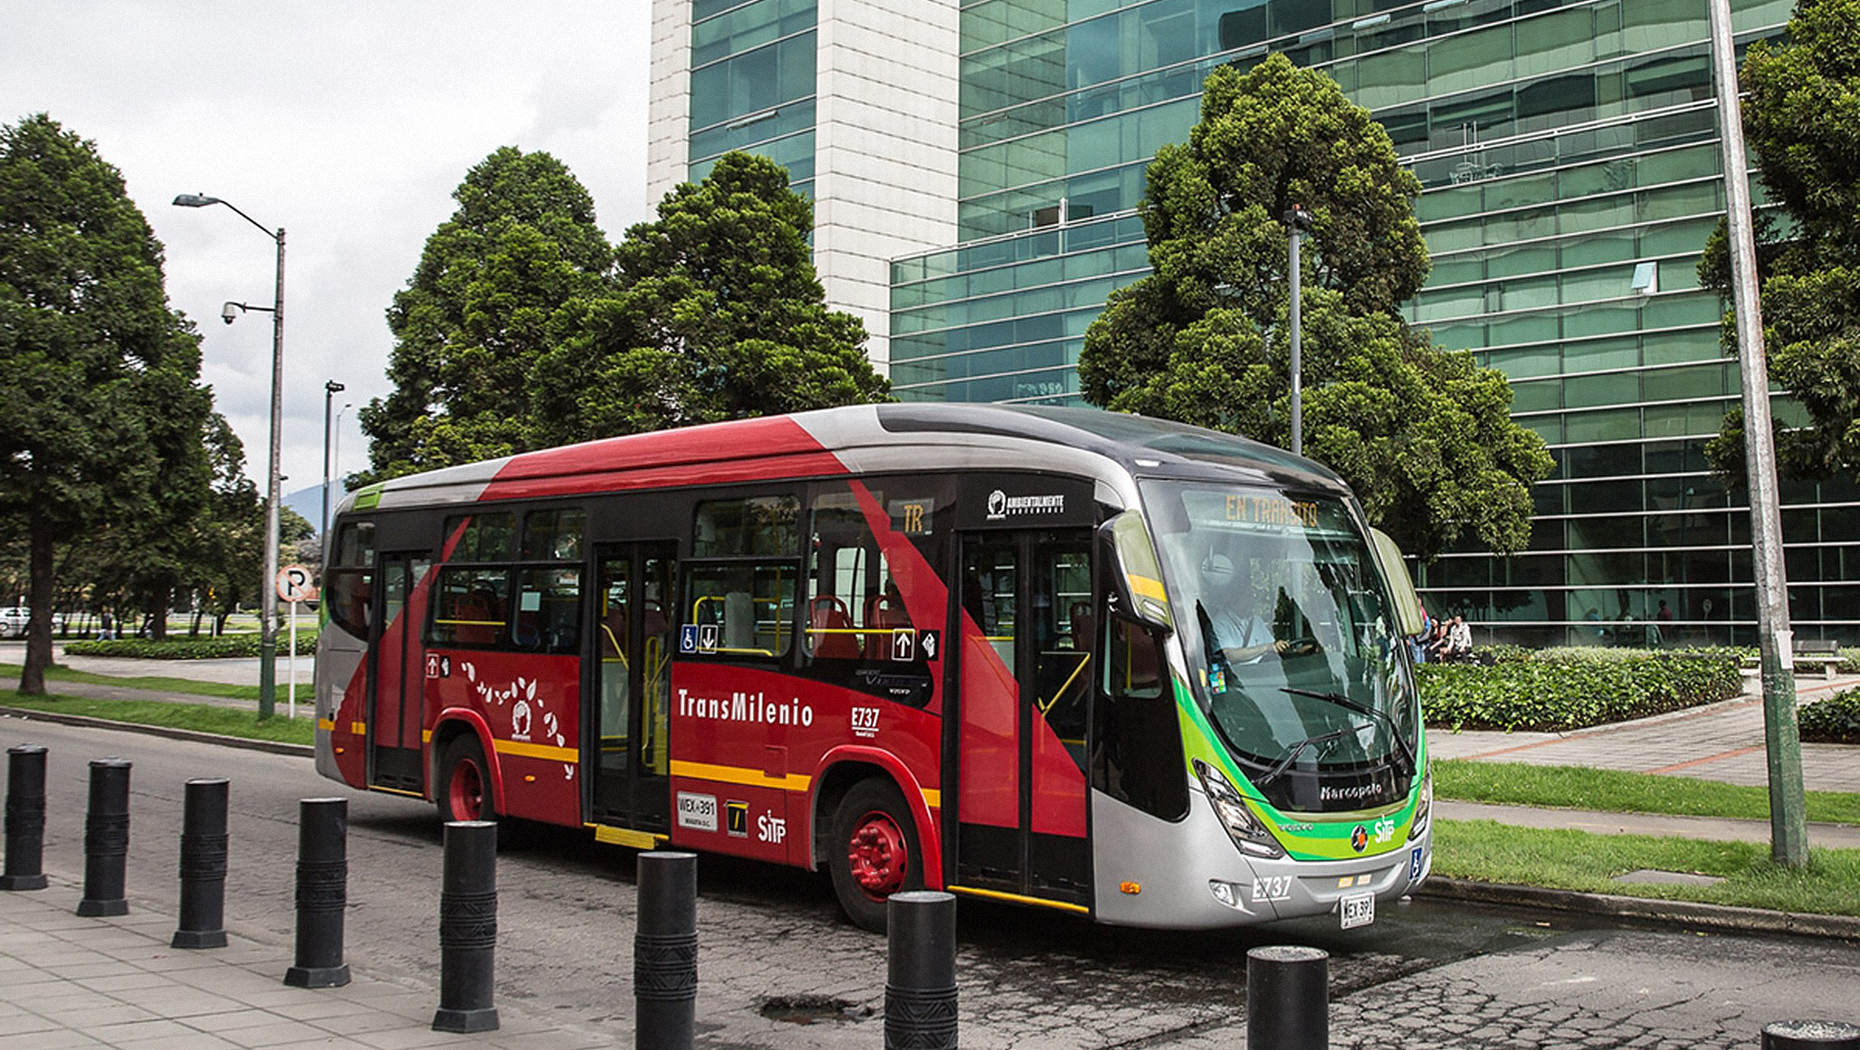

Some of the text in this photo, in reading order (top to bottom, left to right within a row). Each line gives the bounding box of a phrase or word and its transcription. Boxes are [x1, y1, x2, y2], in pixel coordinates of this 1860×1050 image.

[904, 504, 924, 532] TR
[1225, 495, 1246, 520] EN
[678, 688, 813, 727] TransMilenio
[852, 707, 880, 727] E737
[1320, 783, 1382, 800] Marcopolo
[1252, 876, 1292, 898] E737
